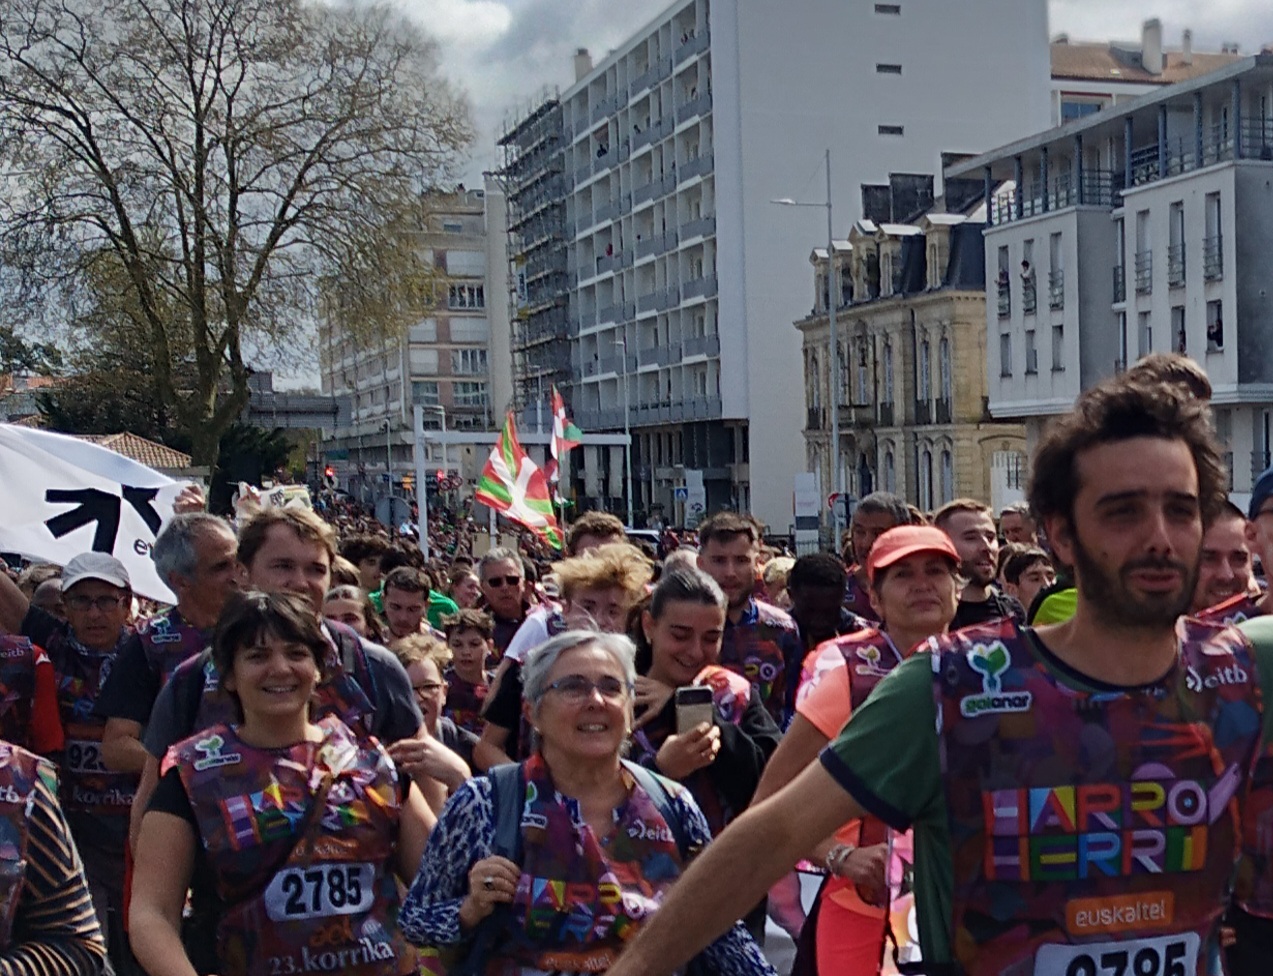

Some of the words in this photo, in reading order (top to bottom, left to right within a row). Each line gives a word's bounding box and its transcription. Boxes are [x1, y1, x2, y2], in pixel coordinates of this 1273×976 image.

[1204, 665, 1248, 688] eitb
[69, 743, 107, 770] 92
[983, 780, 1208, 835] HARRO
[983, 825, 1208, 881] HERRI
[281, 867, 363, 916] 2785
[1075, 900, 1166, 928] euskaltel
[268, 935, 396, 976] 23.korrika
